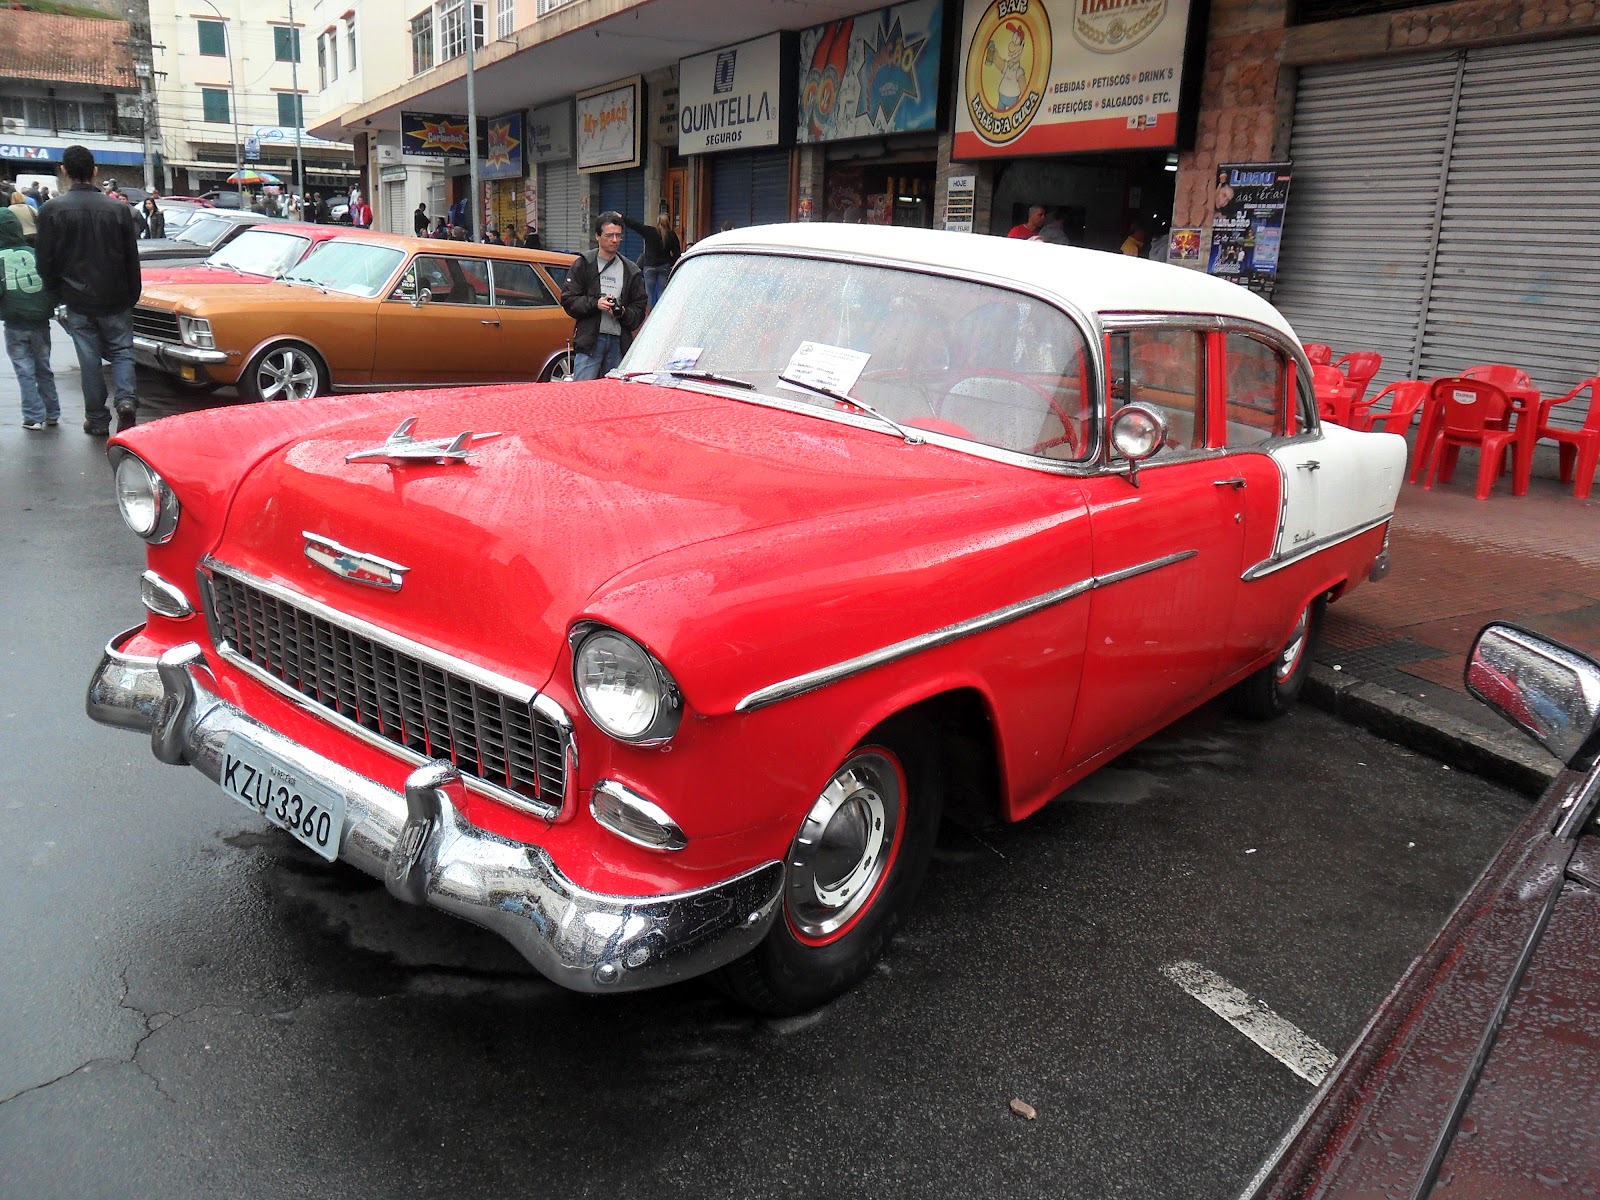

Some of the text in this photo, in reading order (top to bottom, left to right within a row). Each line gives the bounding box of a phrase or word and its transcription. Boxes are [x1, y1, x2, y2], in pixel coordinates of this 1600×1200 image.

[998, 0, 1028, 18] BAR
[1054, 80, 1086, 94] BEBIDAS
[1091, 74, 1131, 89] PETISCOS
[1012, 90, 1039, 129] CUCA
[1052, 91, 1171, 114] REFEIÇÕES SALGADOS ETC.
[583, 113, 598, 139] My
[599, 100, 628, 132] Beach
[681, 91, 770, 134] QUINTELLA
[705, 130, 743, 146] SEGUROS
[0, 145, 49, 159] CAIXA
[1230, 169, 1275, 187] Luau
[1236, 192, 1253, 202] das
[1212, 218, 1250, 228] MARLBORO
[1236, 210, 1247, 219] DJ
